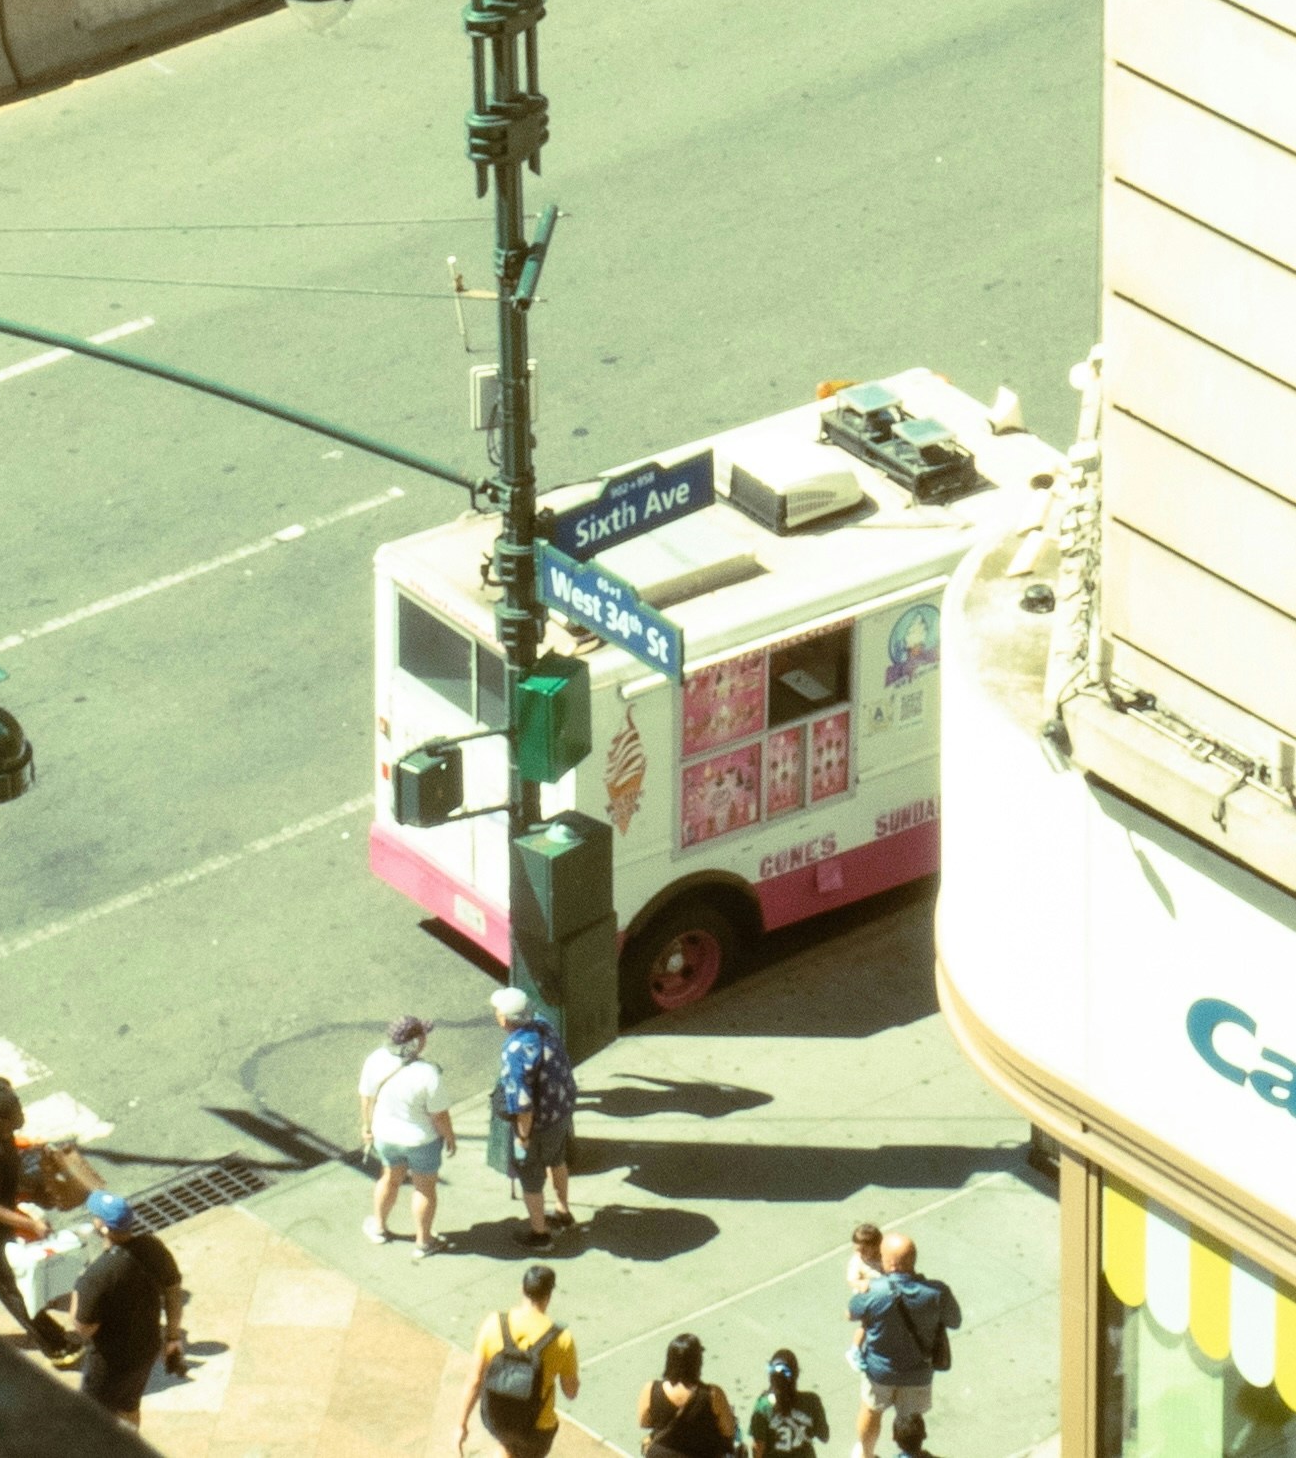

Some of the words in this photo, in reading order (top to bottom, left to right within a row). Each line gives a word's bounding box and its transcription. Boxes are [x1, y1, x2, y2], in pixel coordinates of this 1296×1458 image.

[575, 500, 637, 548] Sixth
[643, 482, 690, 520] Ave
[550, 566, 602, 623] West
[605, 600, 643, 640] 34th
[646, 626, 669, 664] St
[875, 796, 939, 838] SUNDA
